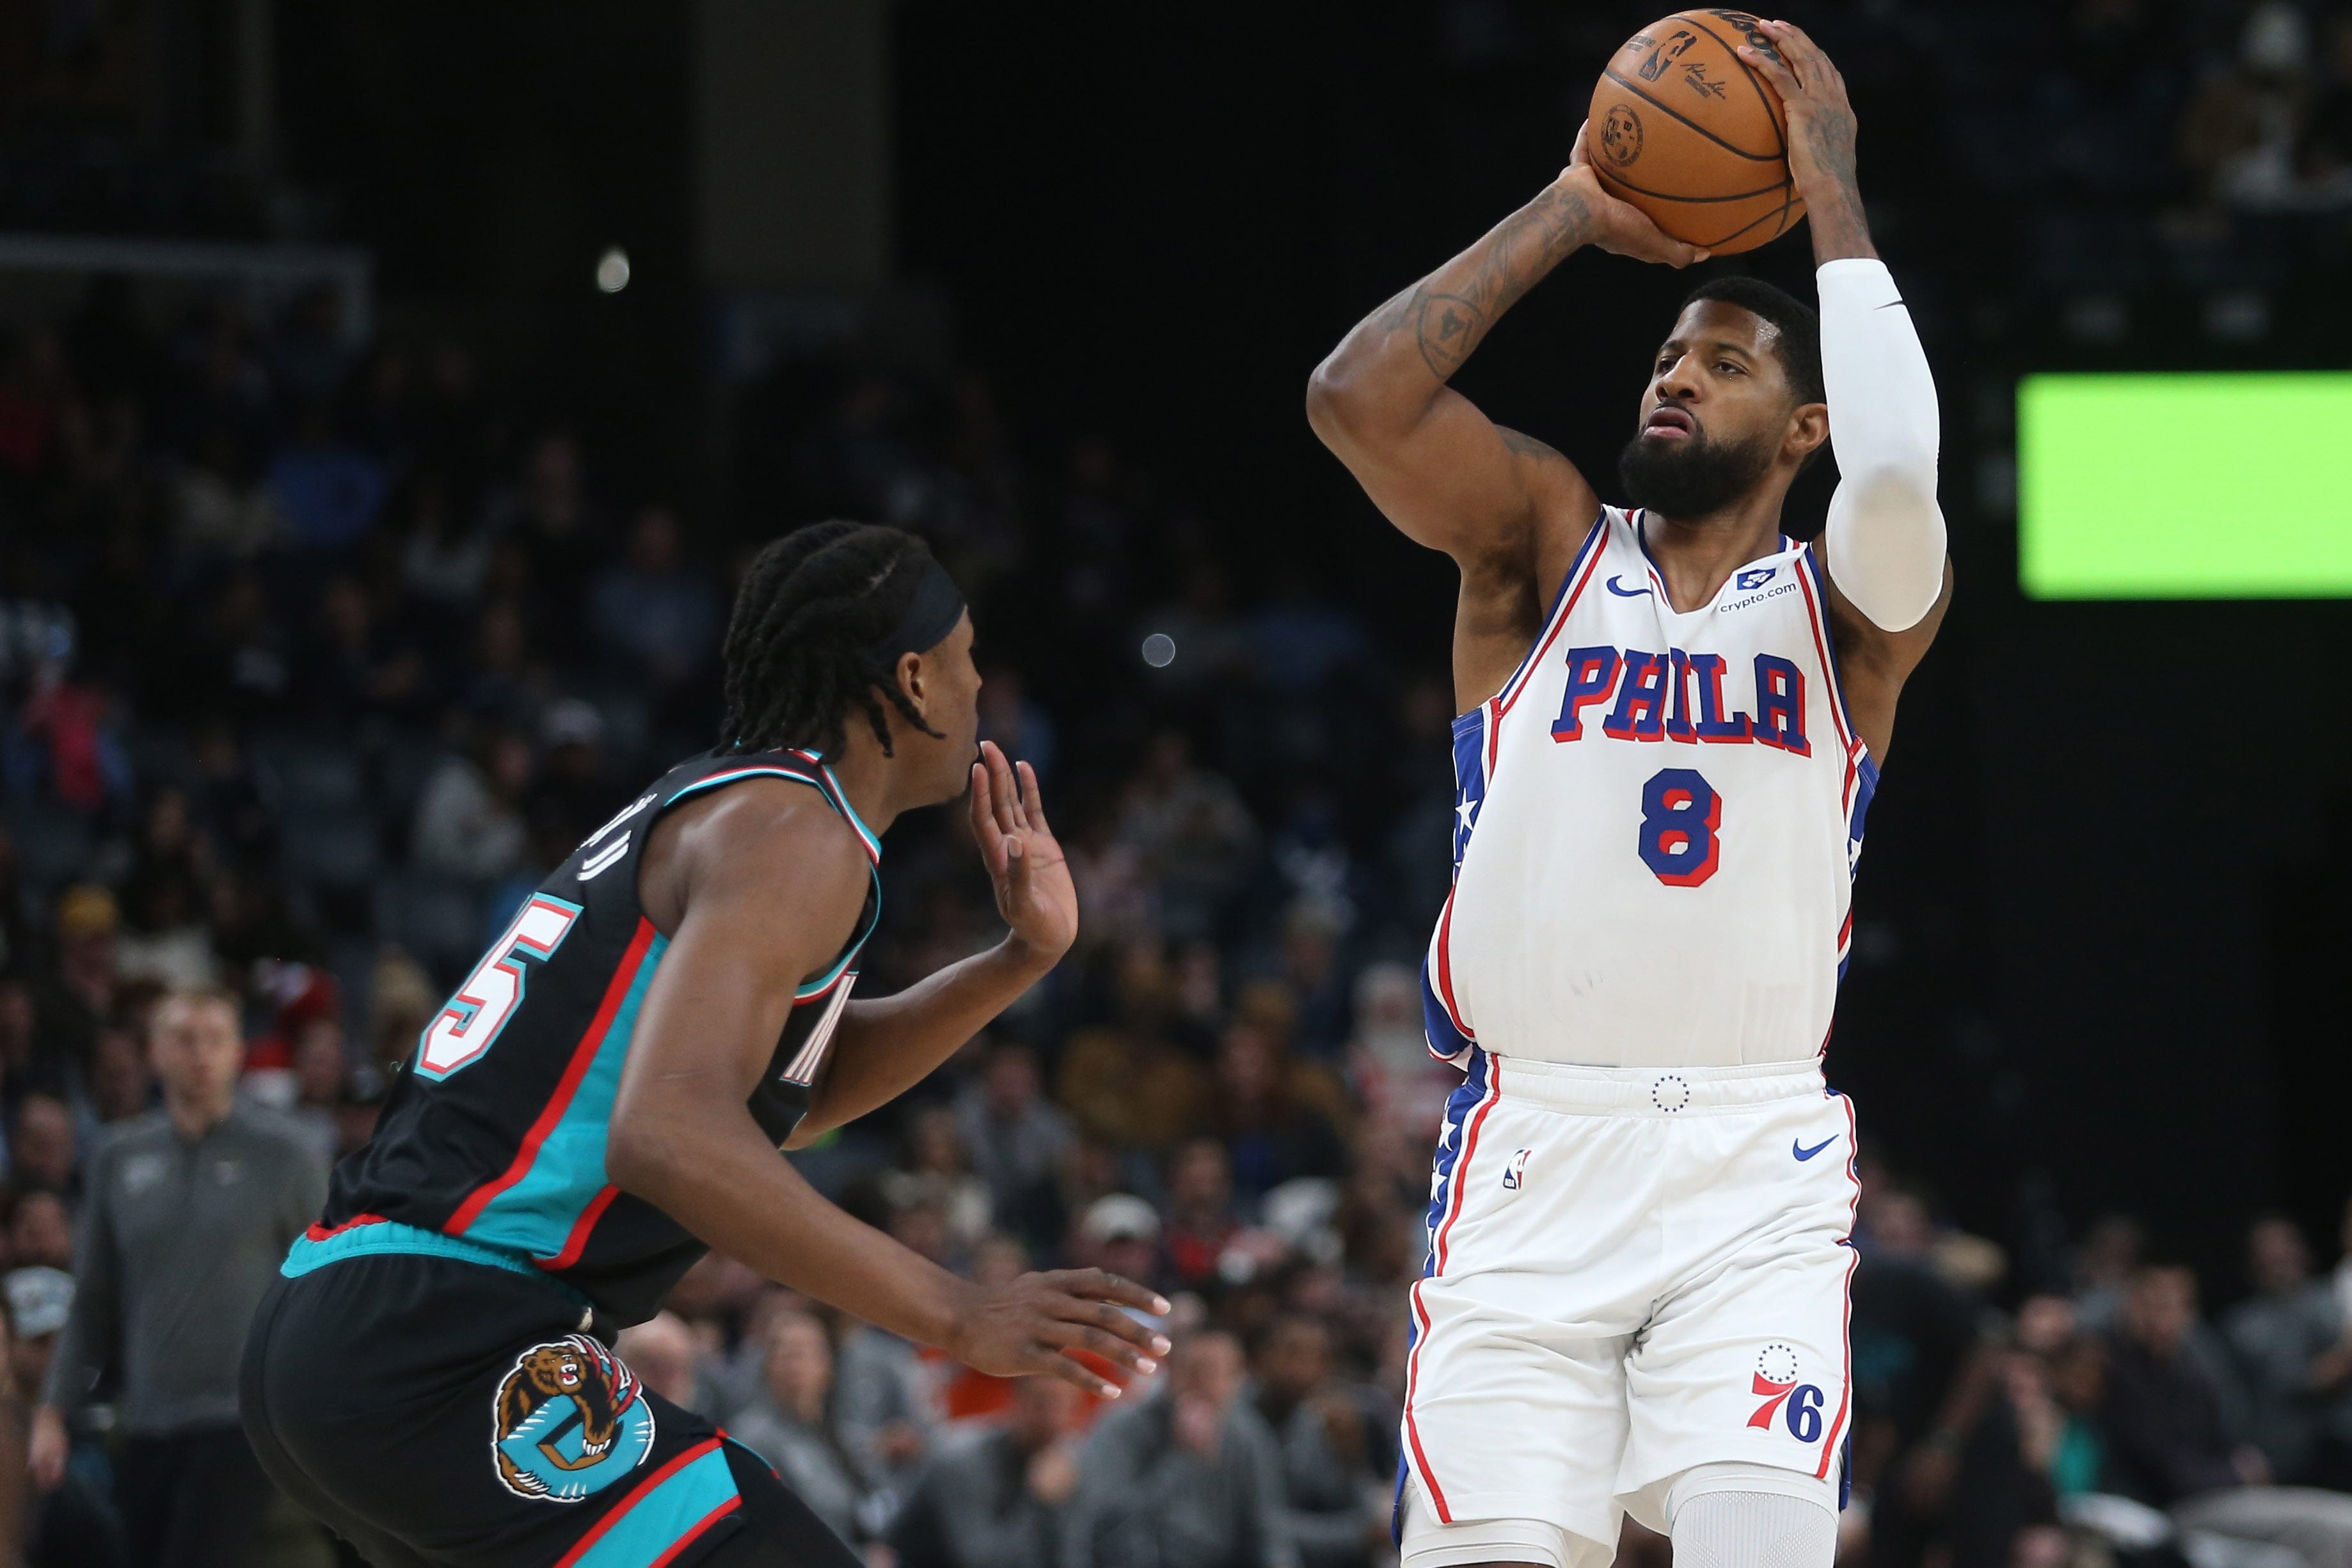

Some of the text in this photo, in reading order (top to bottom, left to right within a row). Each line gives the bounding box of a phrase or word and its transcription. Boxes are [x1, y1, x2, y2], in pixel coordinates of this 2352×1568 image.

[1720, 582, 1797, 613] crypto.com
[1550, 645, 1812, 759] PHILA
[1637, 767, 1722, 888] 8
[1746, 1370, 1824, 1443] 76
